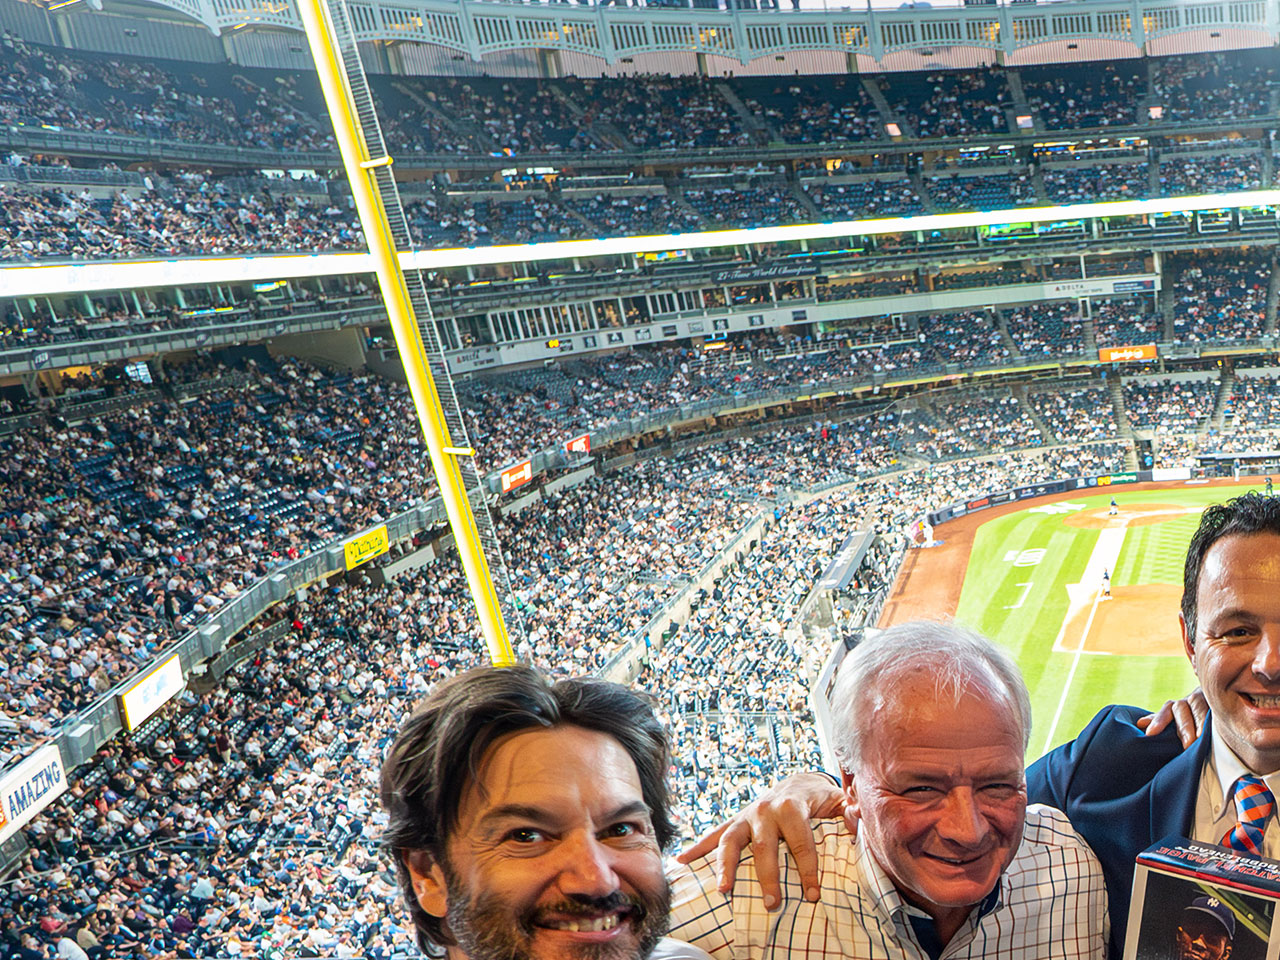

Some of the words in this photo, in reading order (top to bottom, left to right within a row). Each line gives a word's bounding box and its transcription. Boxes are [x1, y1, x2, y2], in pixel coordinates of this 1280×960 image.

[752, 266, 778, 277] World
[8, 761, 61, 820] AMAZING
[1188, 845, 1279, 870] BOBBLEHEAD
